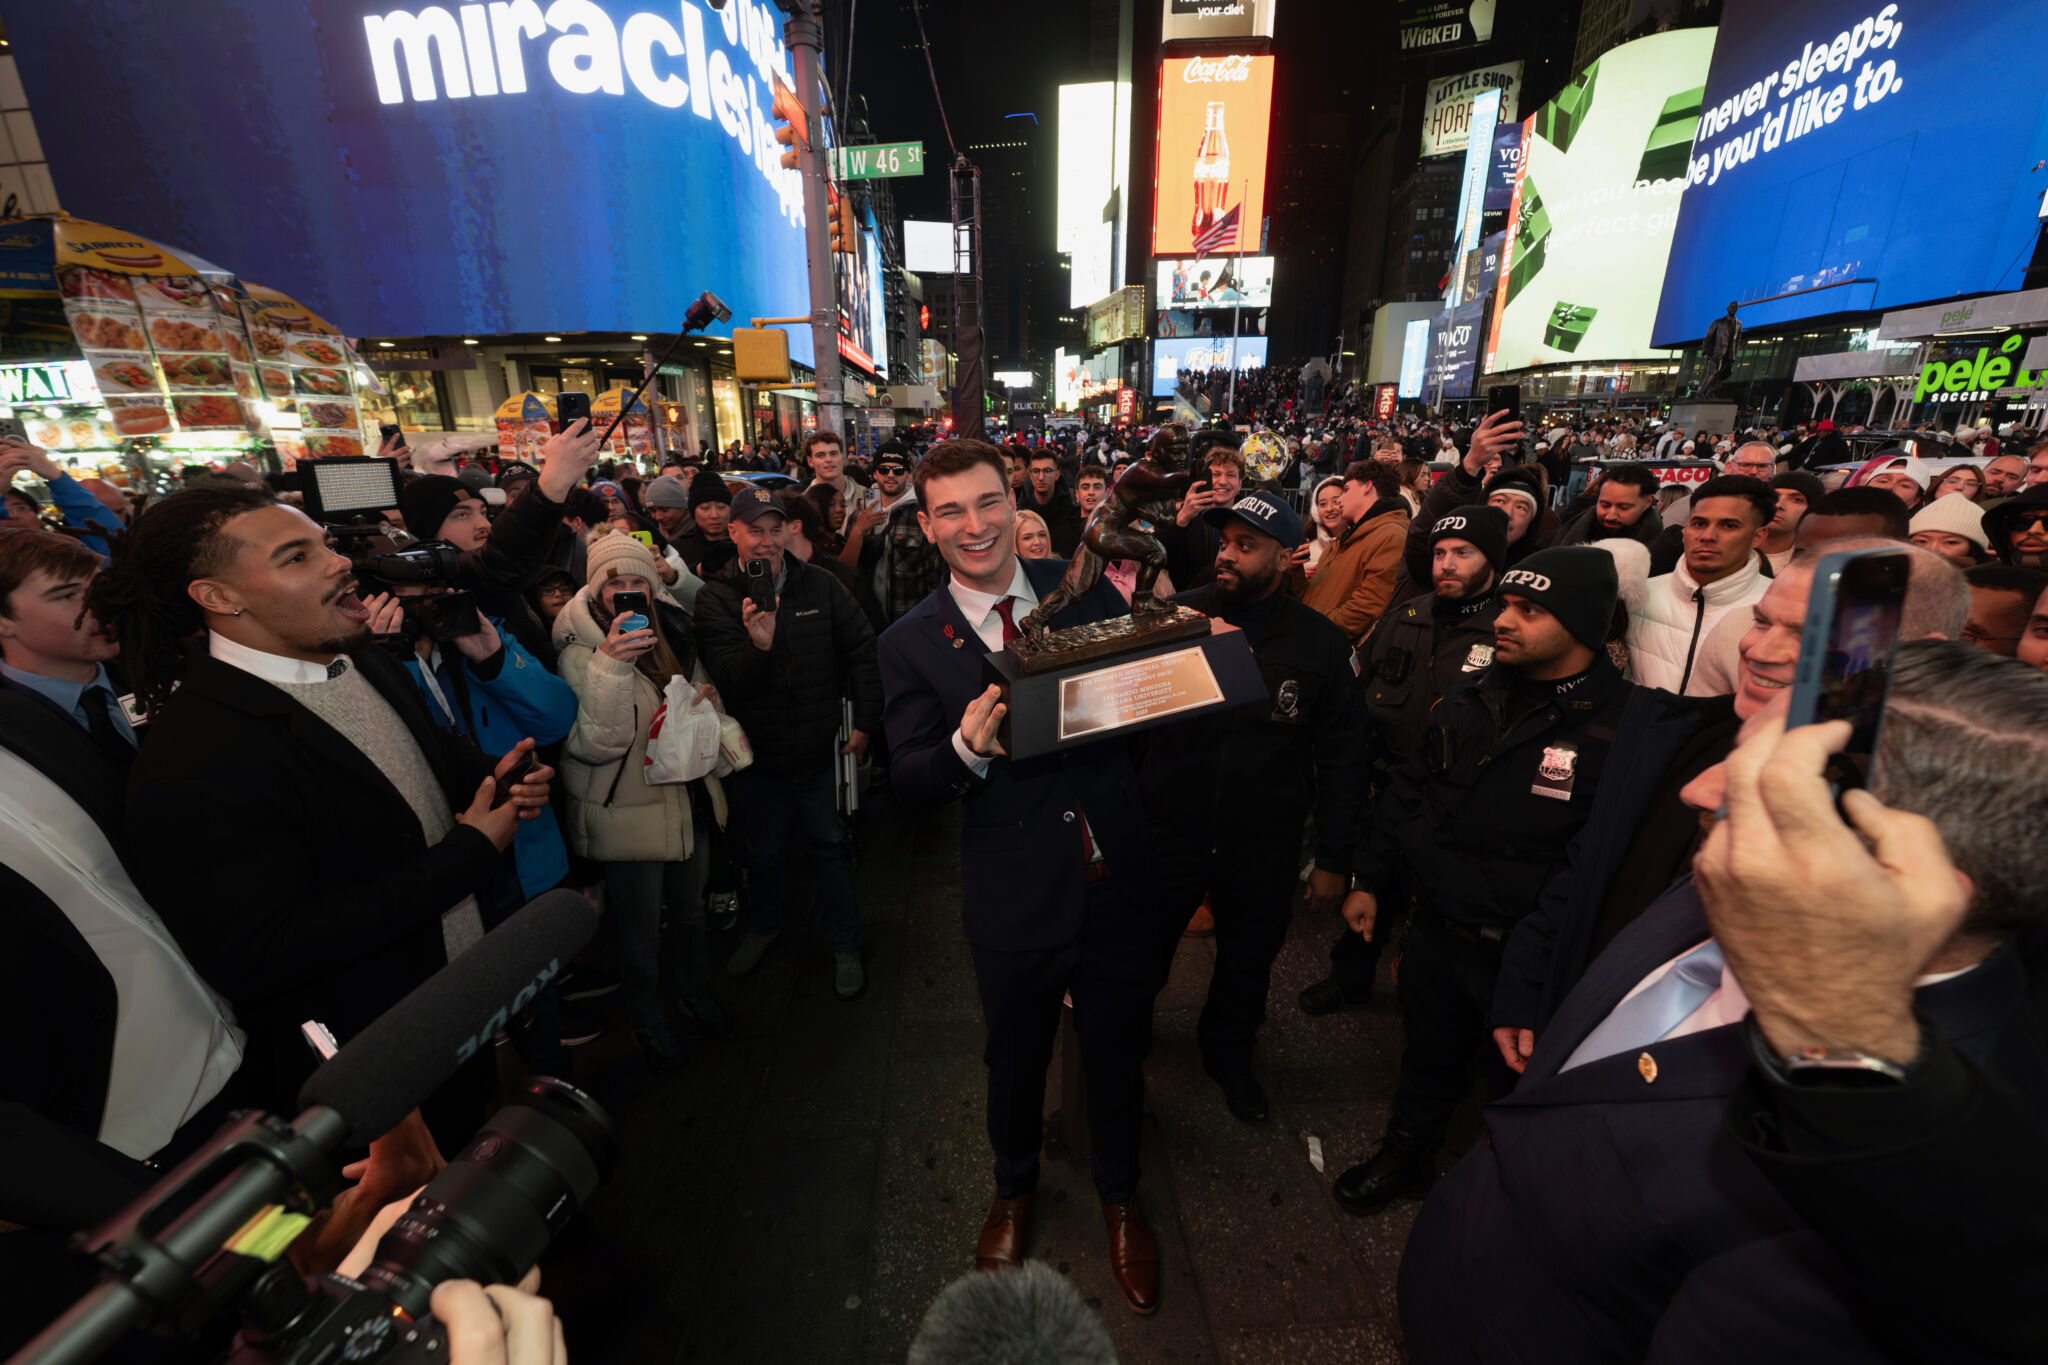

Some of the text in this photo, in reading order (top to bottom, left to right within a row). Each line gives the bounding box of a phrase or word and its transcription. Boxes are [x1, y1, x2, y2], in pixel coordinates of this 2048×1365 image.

[1198, 4, 1244, 20] your diet
[1700, 4, 1903, 142] never sleeps,
[1436, 72, 1513, 105] LITTLE SHOP
[1785, 86, 1847, 144] like
[1853, 59, 1903, 111] to.
[850, 146, 920, 175] W 46 St
[1914, 334, 2022, 403] pelé
[1121, 390, 1133, 414] tkts
[1380, 388, 1394, 413] tkts
[1931, 391, 1989, 402] SOCCER
[1650, 467, 1711, 483] CAGO
[1232, 496, 1277, 520] URITY
